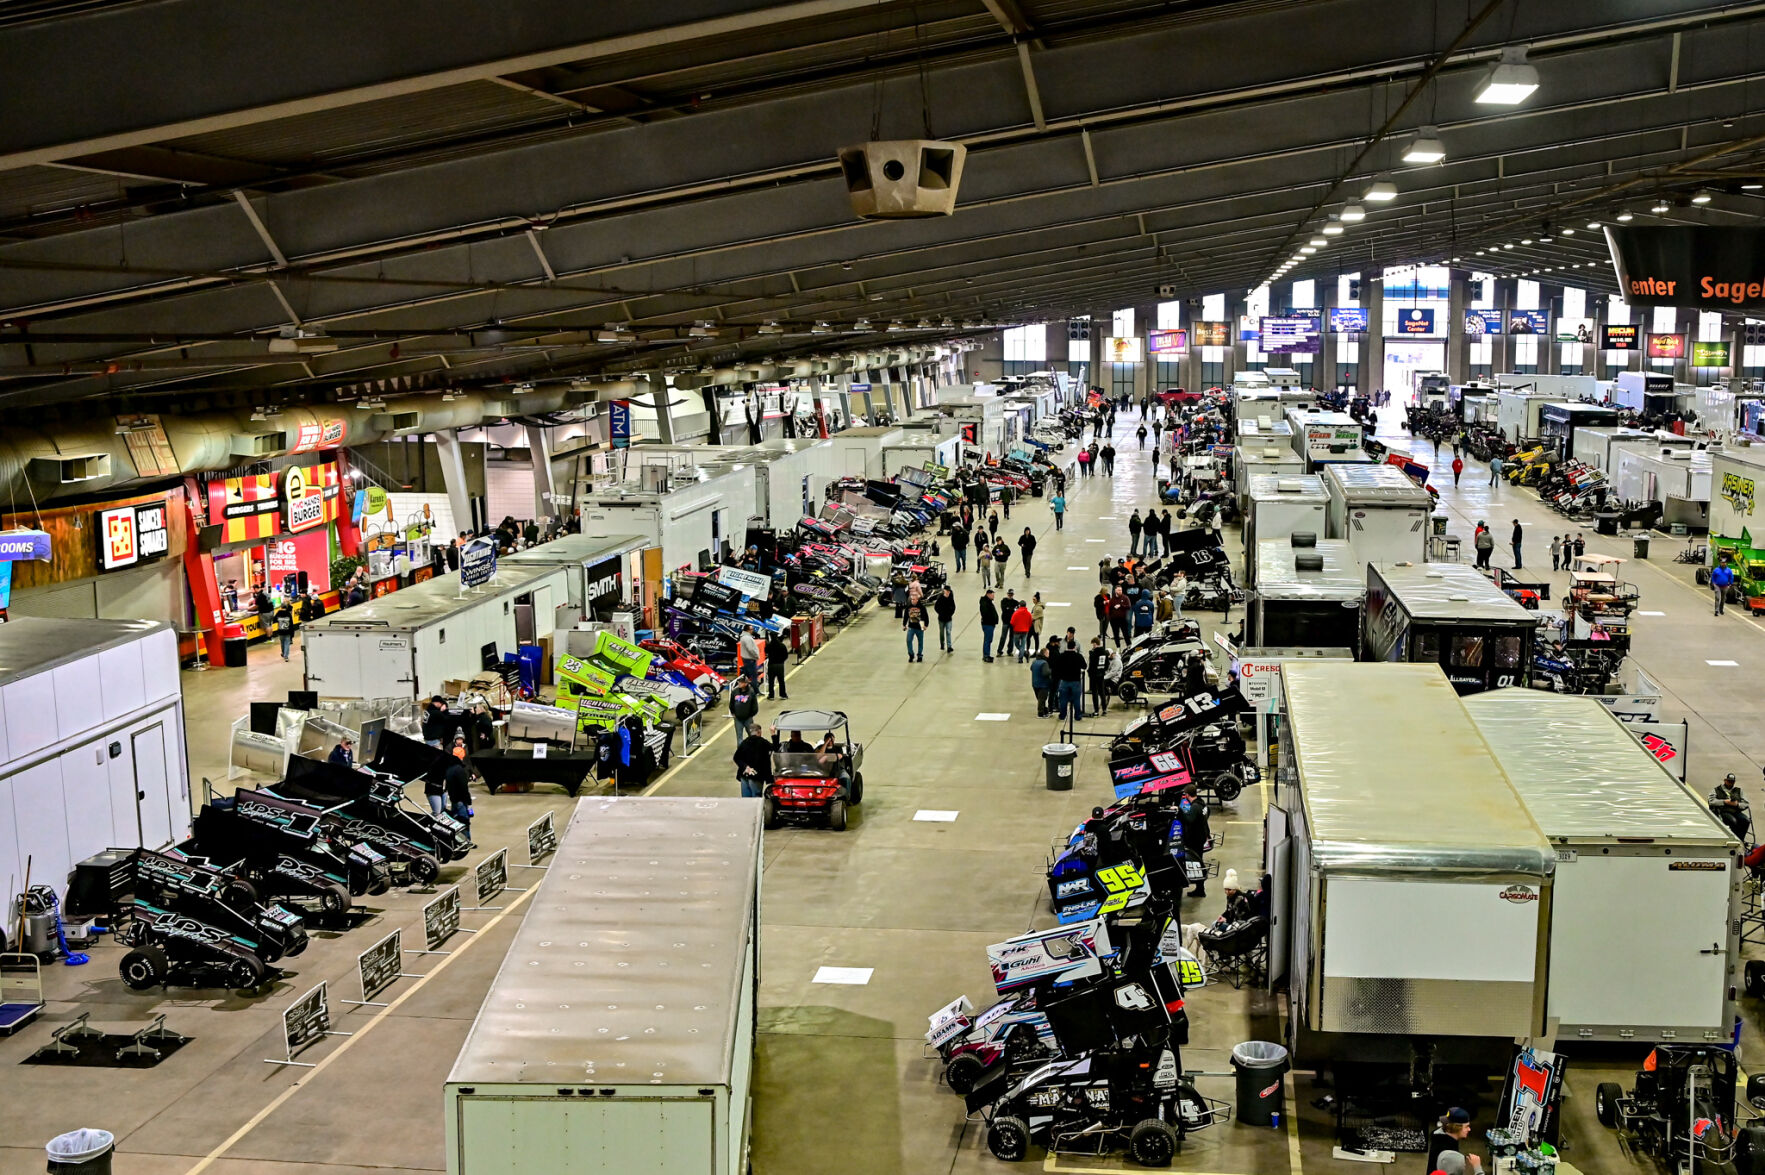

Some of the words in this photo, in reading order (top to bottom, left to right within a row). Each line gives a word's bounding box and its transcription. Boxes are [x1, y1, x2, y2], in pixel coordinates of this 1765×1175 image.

[1701, 276, 1765, 304] Sage
[612, 404, 625, 435] ATM
[293, 504, 321, 523] BURGER
[0, 542, 34, 553] OOMS
[277, 541, 296, 554] IG
[1191, 549, 1213, 565] 16
[588, 573, 617, 601] SMITH
[717, 616, 746, 633] SMIT
[563, 658, 581, 673] 23
[1497, 675, 1515, 688] 01
[281, 812, 320, 839] 1
[180, 869, 218, 895] 1
[1097, 864, 1145, 893] 95
[1010, 955, 1042, 969] Guhl
[304, 987, 326, 1024] 1
[931, 1021, 957, 1042] ADAMS
[1516, 1057, 1550, 1105] 1
